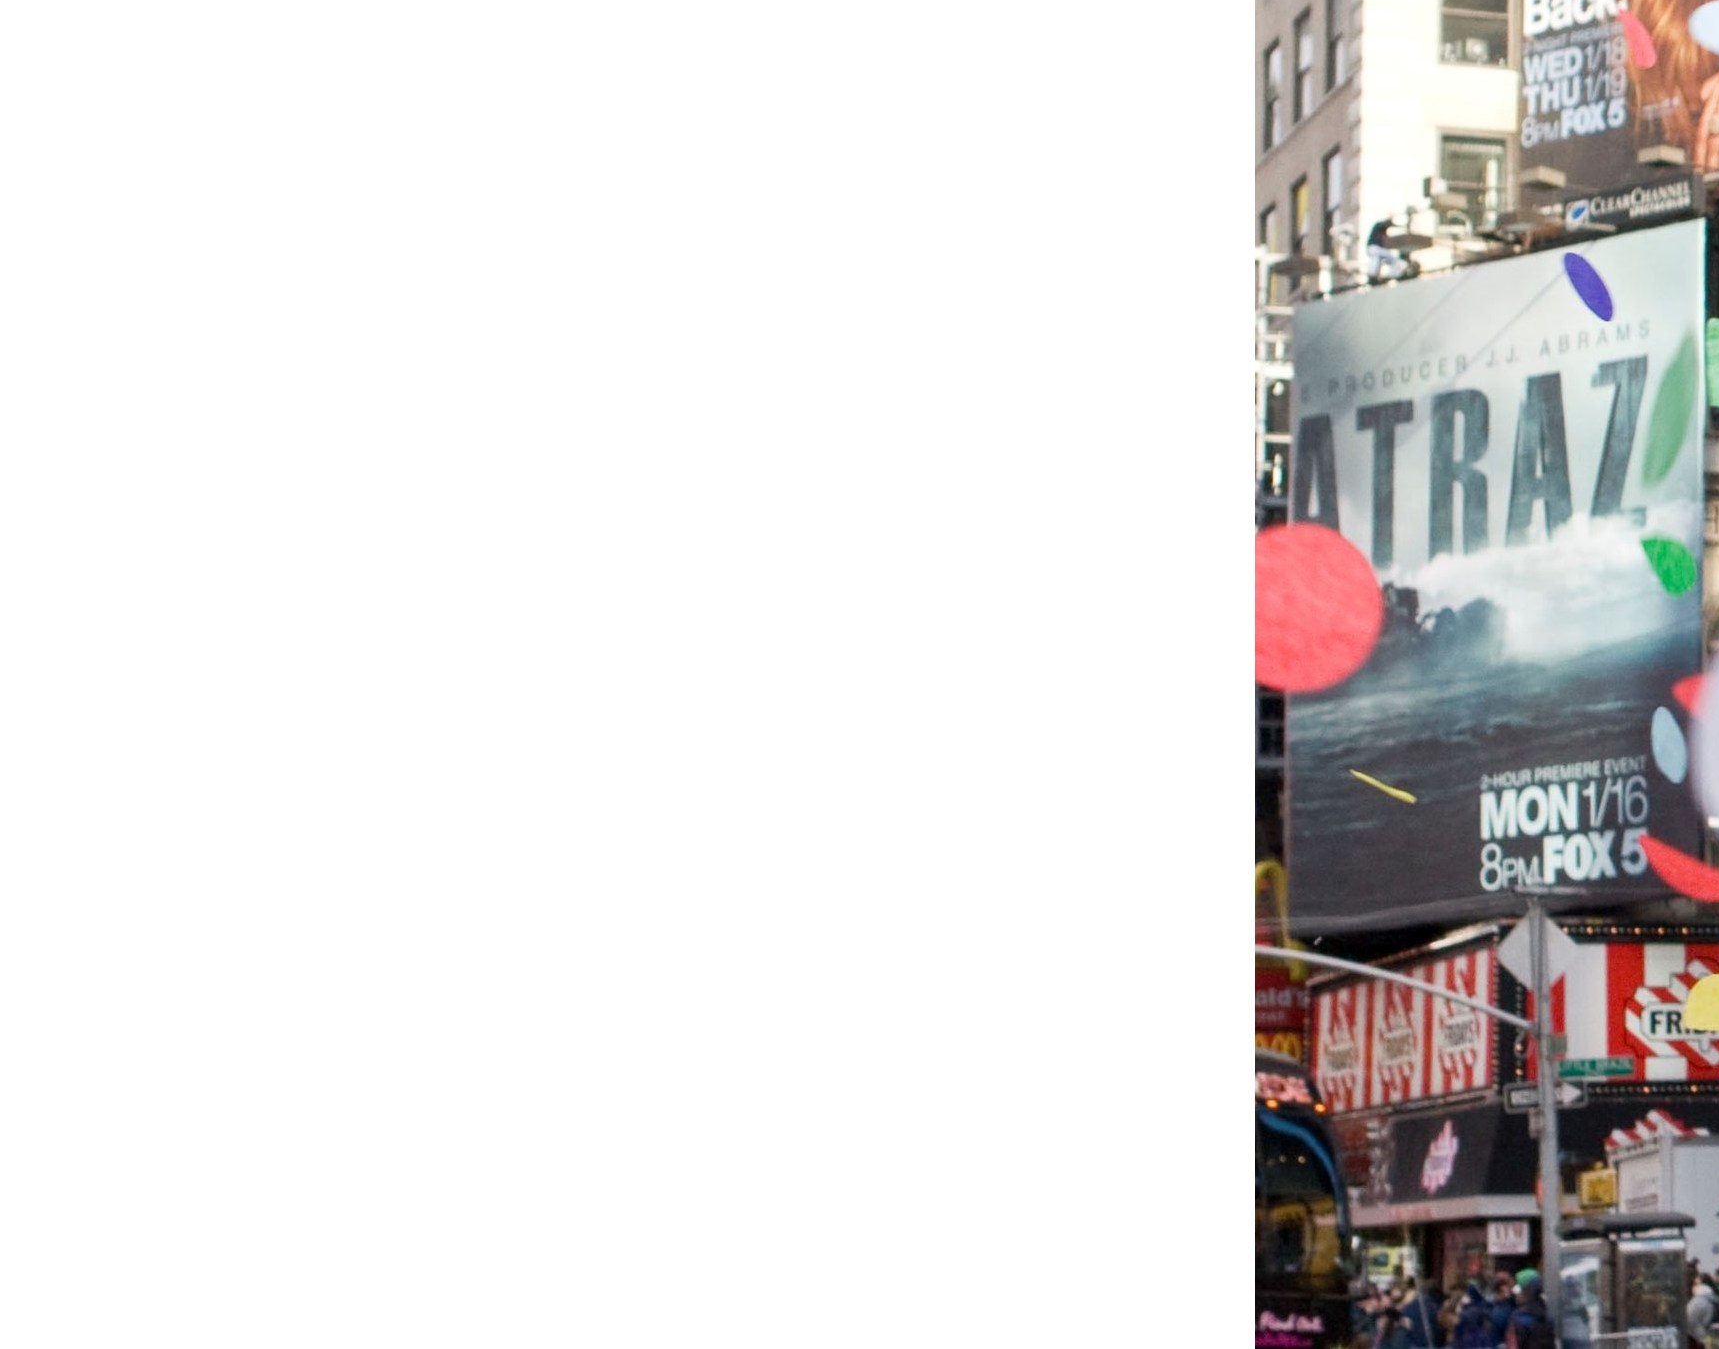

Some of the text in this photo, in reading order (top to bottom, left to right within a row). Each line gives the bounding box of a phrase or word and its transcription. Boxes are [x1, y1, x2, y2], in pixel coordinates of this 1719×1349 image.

[1523, 36, 1629, 86] WED 1/18
[1523, 65, 1629, 117] THU 1/19
[1521, 115, 1560, 148] 8PM
[1560, 100, 1606, 140] FOX
[1607, 98, 1626, 129] 5
[1328, 356, 1469, 395] PRODUCER
[1486, 346, 1519, 369] J.J.
[1539, 320, 1651, 357] ABRAMS
[1480, 754, 1648, 791] 2-HOUR PREMIERE EVENT
[1480, 775, 1649, 841] MON 1/16
[1543, 829, 1618, 885] FOX
[1620, 827, 1649, 875] 5
